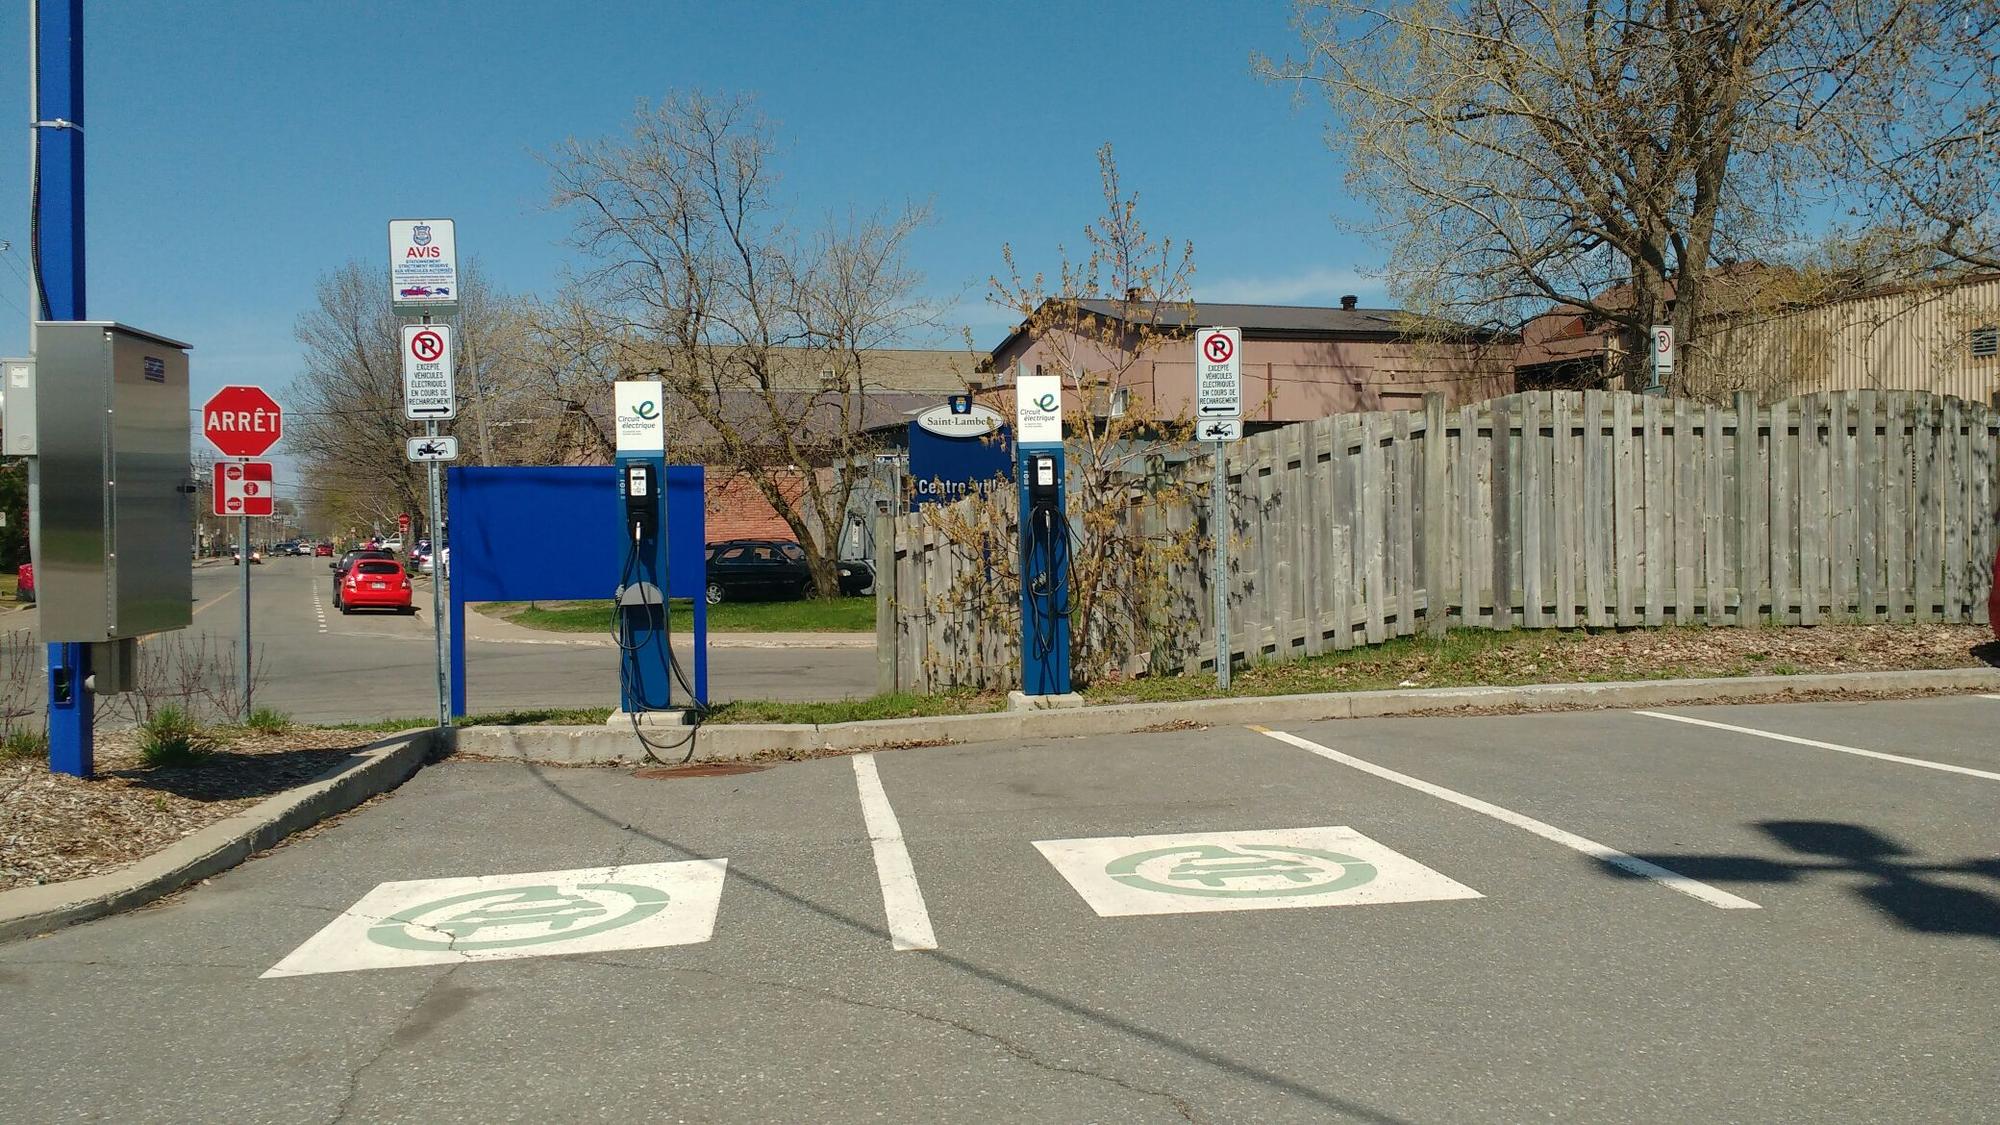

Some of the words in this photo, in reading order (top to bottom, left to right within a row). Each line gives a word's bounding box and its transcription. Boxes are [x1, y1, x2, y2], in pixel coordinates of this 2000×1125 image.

[406, 246, 440, 258] AVIS
[1200, 397, 1238, 405] RECHARGEMENT
[207, 408, 278, 432] ARRÊT
[927, 416, 997, 426] Saint-Lambe
